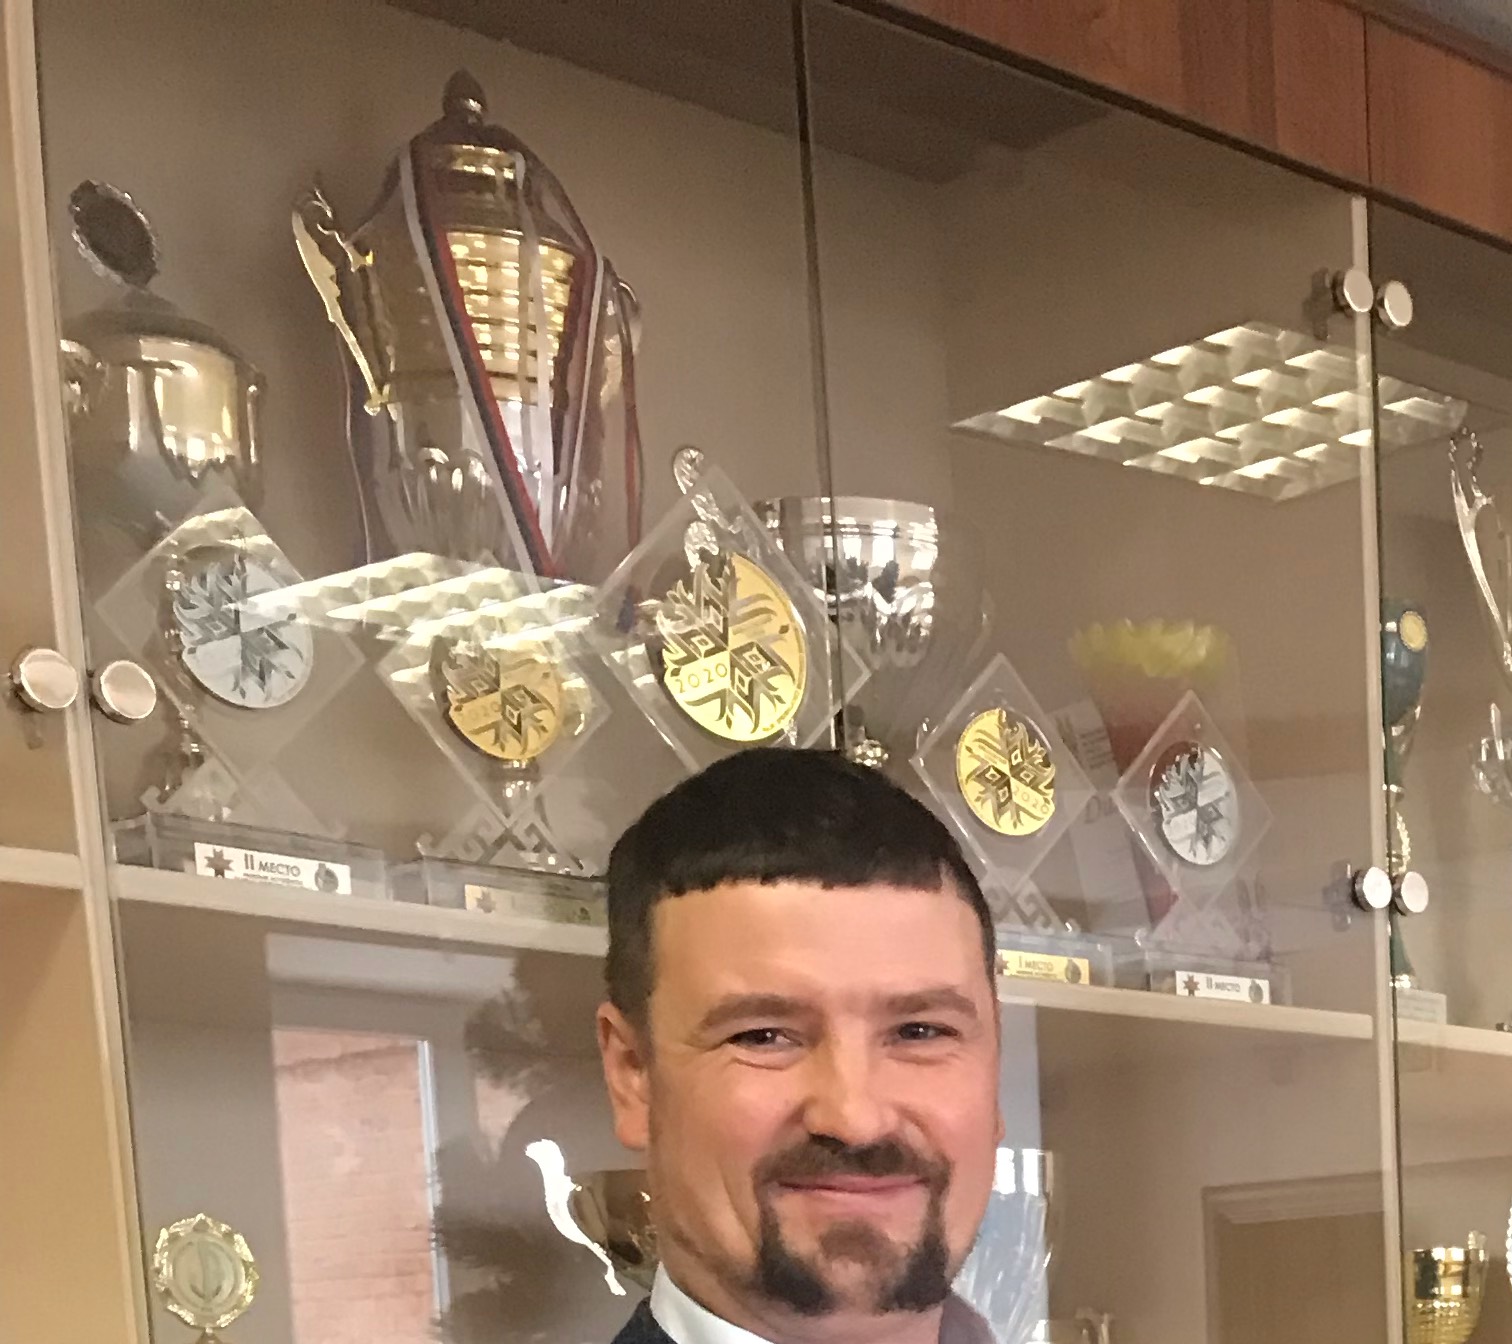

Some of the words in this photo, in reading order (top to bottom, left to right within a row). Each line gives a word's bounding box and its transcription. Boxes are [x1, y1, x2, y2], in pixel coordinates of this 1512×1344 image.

[674, 662, 728, 694] 2020
[1013, 784, 1050, 816] 2020
[257, 860, 301, 878] МЕСТО
